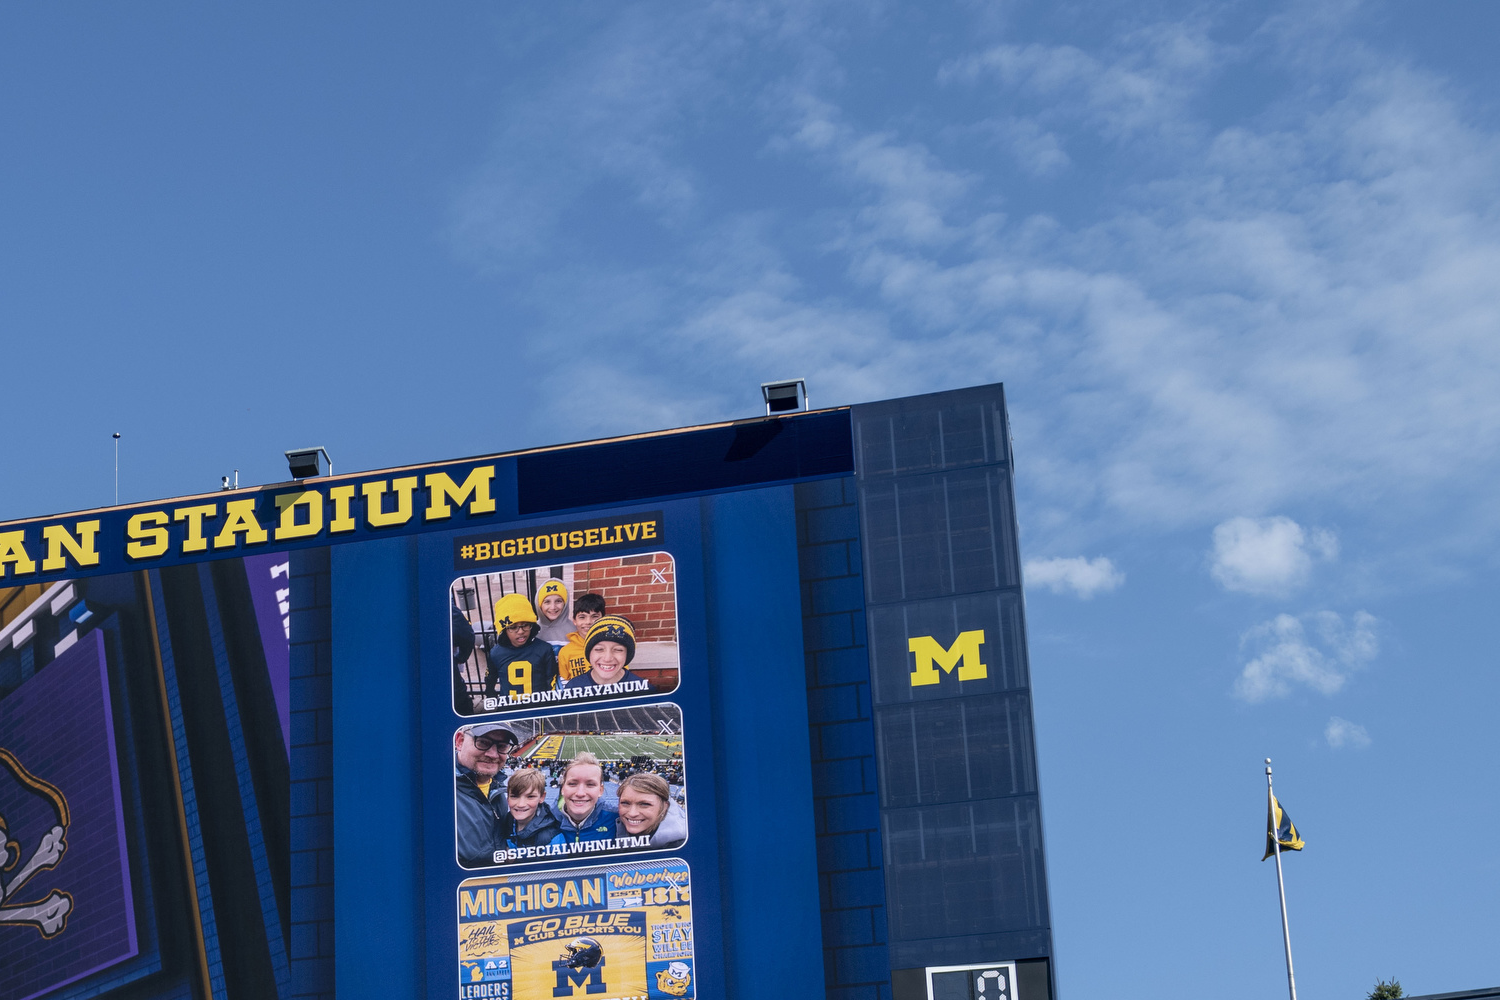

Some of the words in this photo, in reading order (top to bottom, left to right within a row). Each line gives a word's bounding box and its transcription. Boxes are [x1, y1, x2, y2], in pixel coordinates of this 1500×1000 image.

[127, 465, 496, 560] STADIUM
[460, 521, 657, 561] #BIGHOUSELIVE
[499, 616, 513, 628] M
[569, 657, 585, 668] THE
[908, 629, 987, 687] M
[507, 661, 532, 698] 9
[483, 679, 650, 711] @ALISONNARAYANUM
[493, 835, 651, 863] @SPECIALWHNLITMI
[460, 878, 603, 918] MICHIGAN
[468, 925, 495, 939] HAIL
[525, 918, 560, 936] GO
[564, 913, 631, 930] BLUE
[528, 931, 555, 942] CLUB
[558, 926, 614, 938] SUPPORTS
[617, 925, 642, 935] YOU
[652, 928, 692, 943] STAY
[653, 943, 678, 953] WILL
[461, 982, 509, 999] LEADERS
